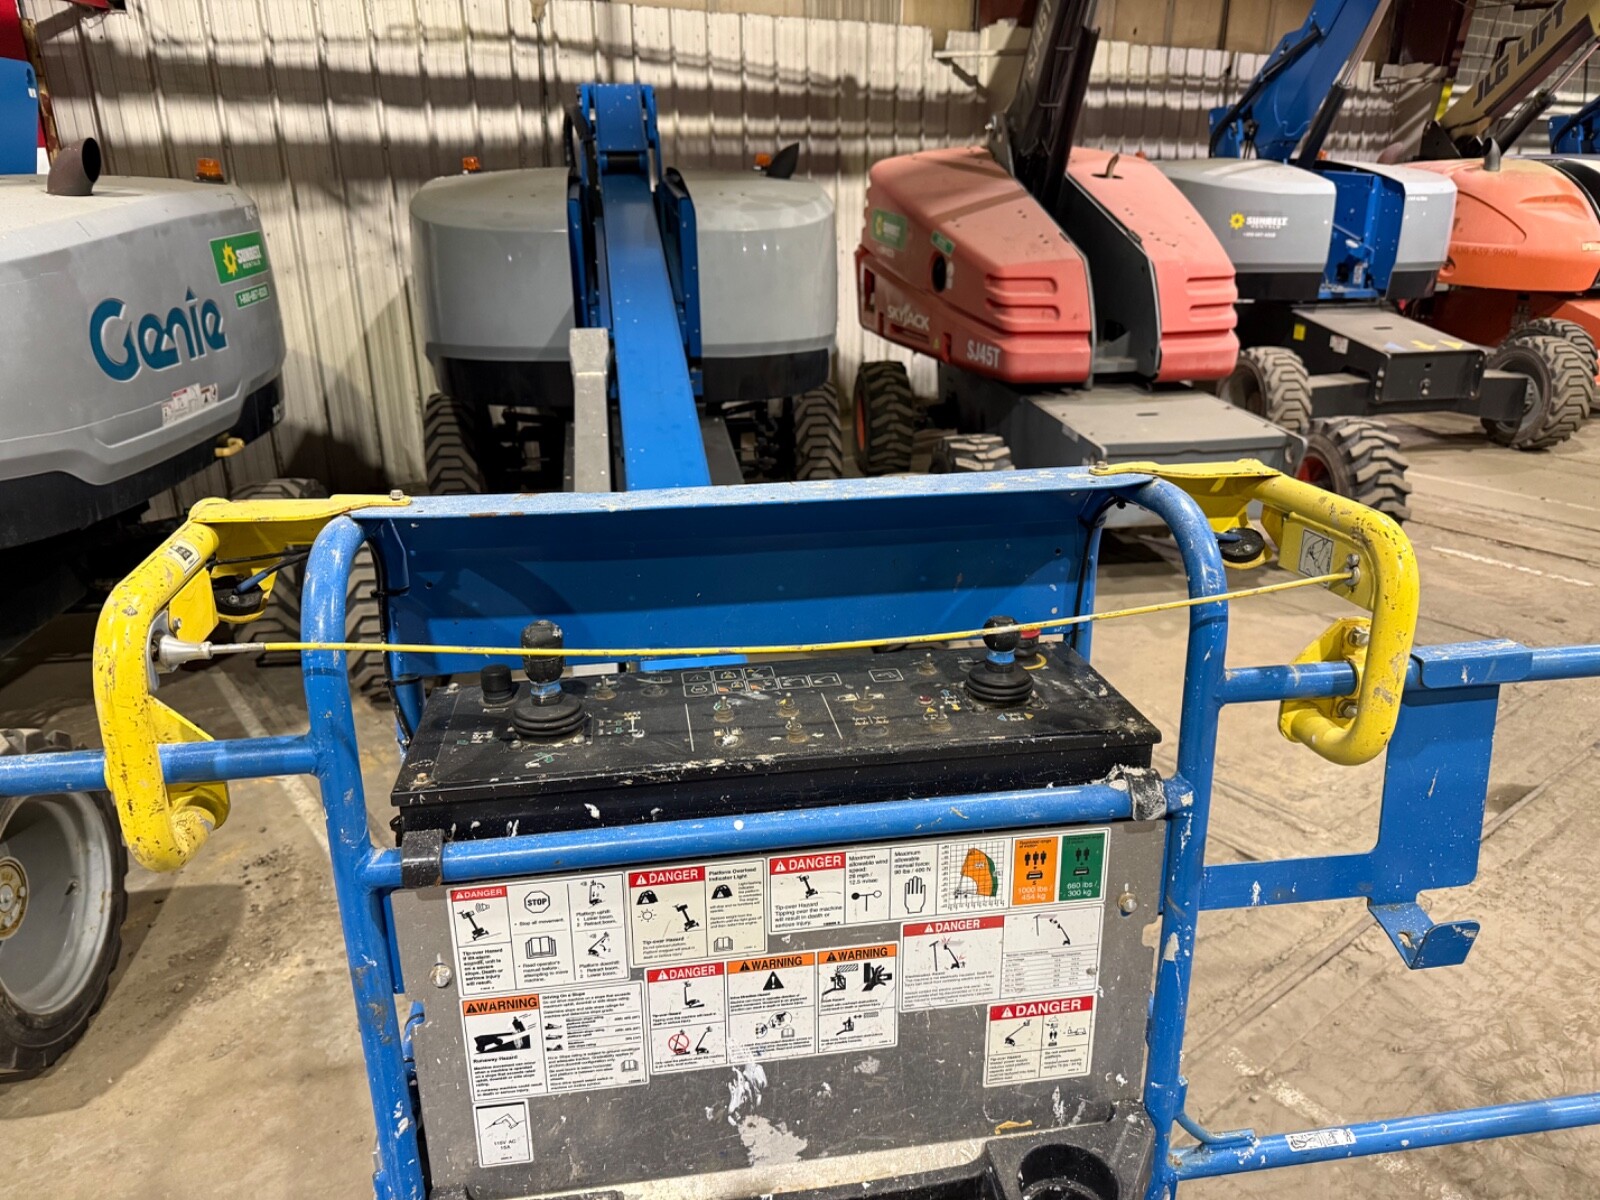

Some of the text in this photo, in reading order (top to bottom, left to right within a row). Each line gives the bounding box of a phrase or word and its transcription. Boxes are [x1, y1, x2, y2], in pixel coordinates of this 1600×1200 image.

[1473, 0, 1567, 107] JLG LIFT
[1246, 216, 1288, 226] SUNBELT
[887, 303, 931, 331] SKYJACK
[89, 286, 230, 383] Genie
[966, 339, 1001, 369] SJ45T
[789, 857, 841, 870] DANGER
[649, 870, 698, 883] DANGER
[464, 889, 502, 898] DANGER
[1017, 886, 1036, 894] 1000
[1067, 888, 1092, 897] 300 kg
[527, 898, 547, 906] STOP
[1021, 892, 1046, 902] 454 kg
[936, 921, 980, 932] DANGER
[838, 947, 888, 961] WARNING
[752, 956, 802, 970] WARNING
[670, 966, 716, 979] DANGER
[478, 997, 537, 1013] WARNING
[1016, 1000, 1082, 1016] DANGER
